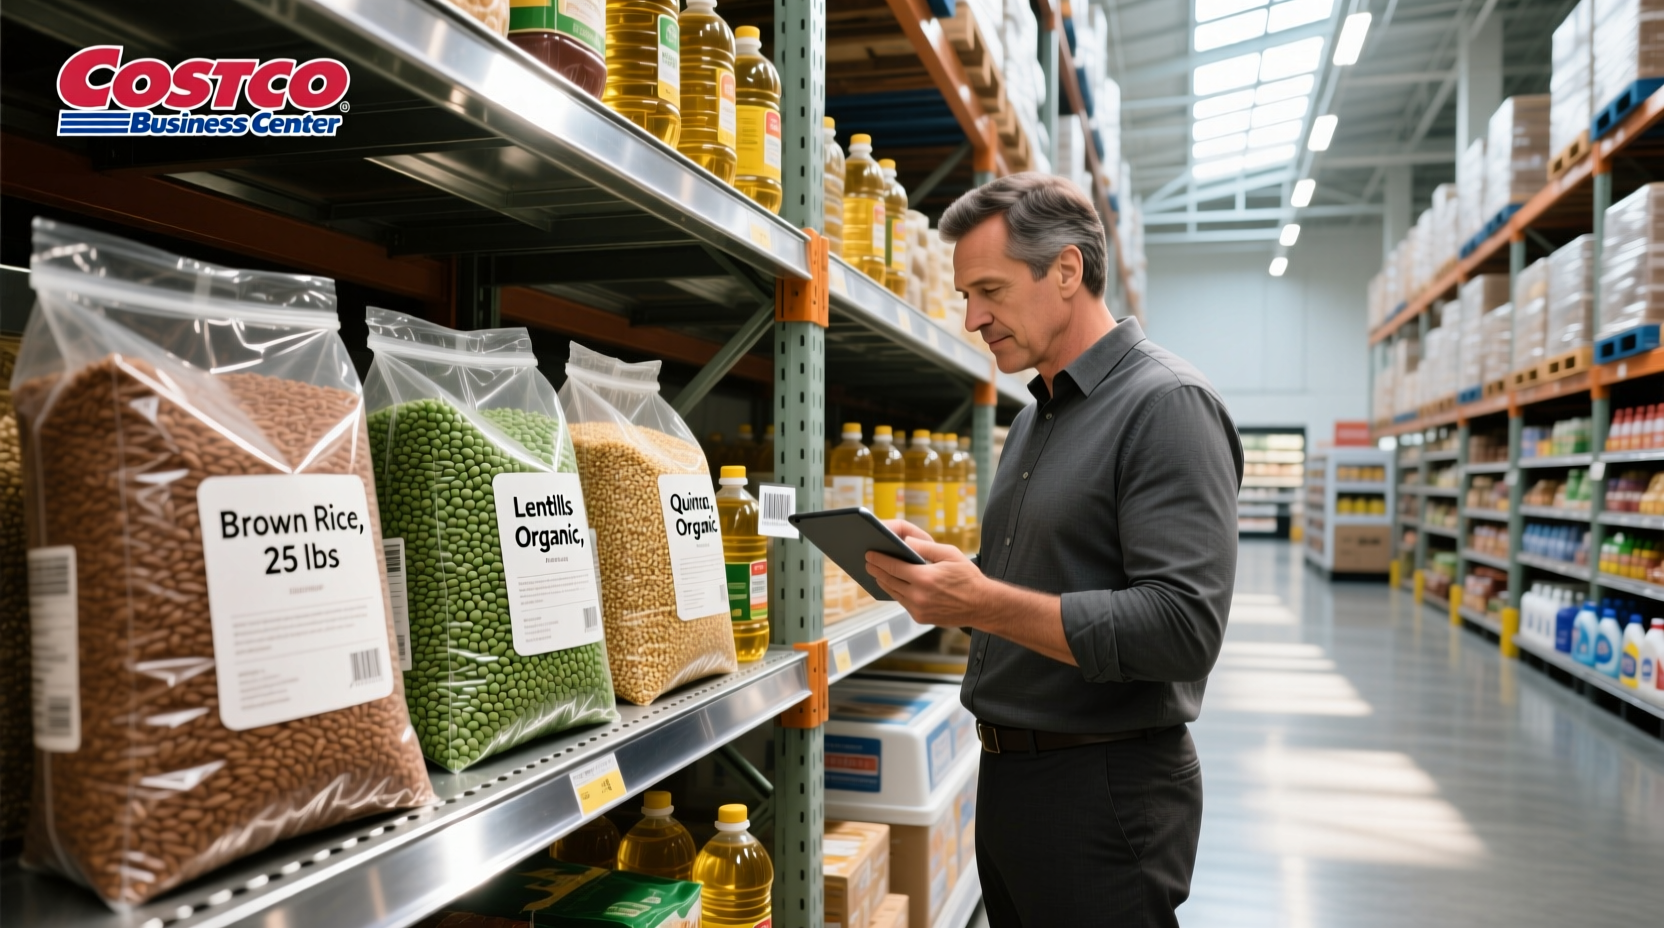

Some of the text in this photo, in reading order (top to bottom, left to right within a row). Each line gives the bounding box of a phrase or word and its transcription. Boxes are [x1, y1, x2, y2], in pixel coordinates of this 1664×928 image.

[220, 503, 364, 538] Brown Rice,
[515, 523, 584, 552] Organic,
[264, 542, 340, 574] 25 lbs
